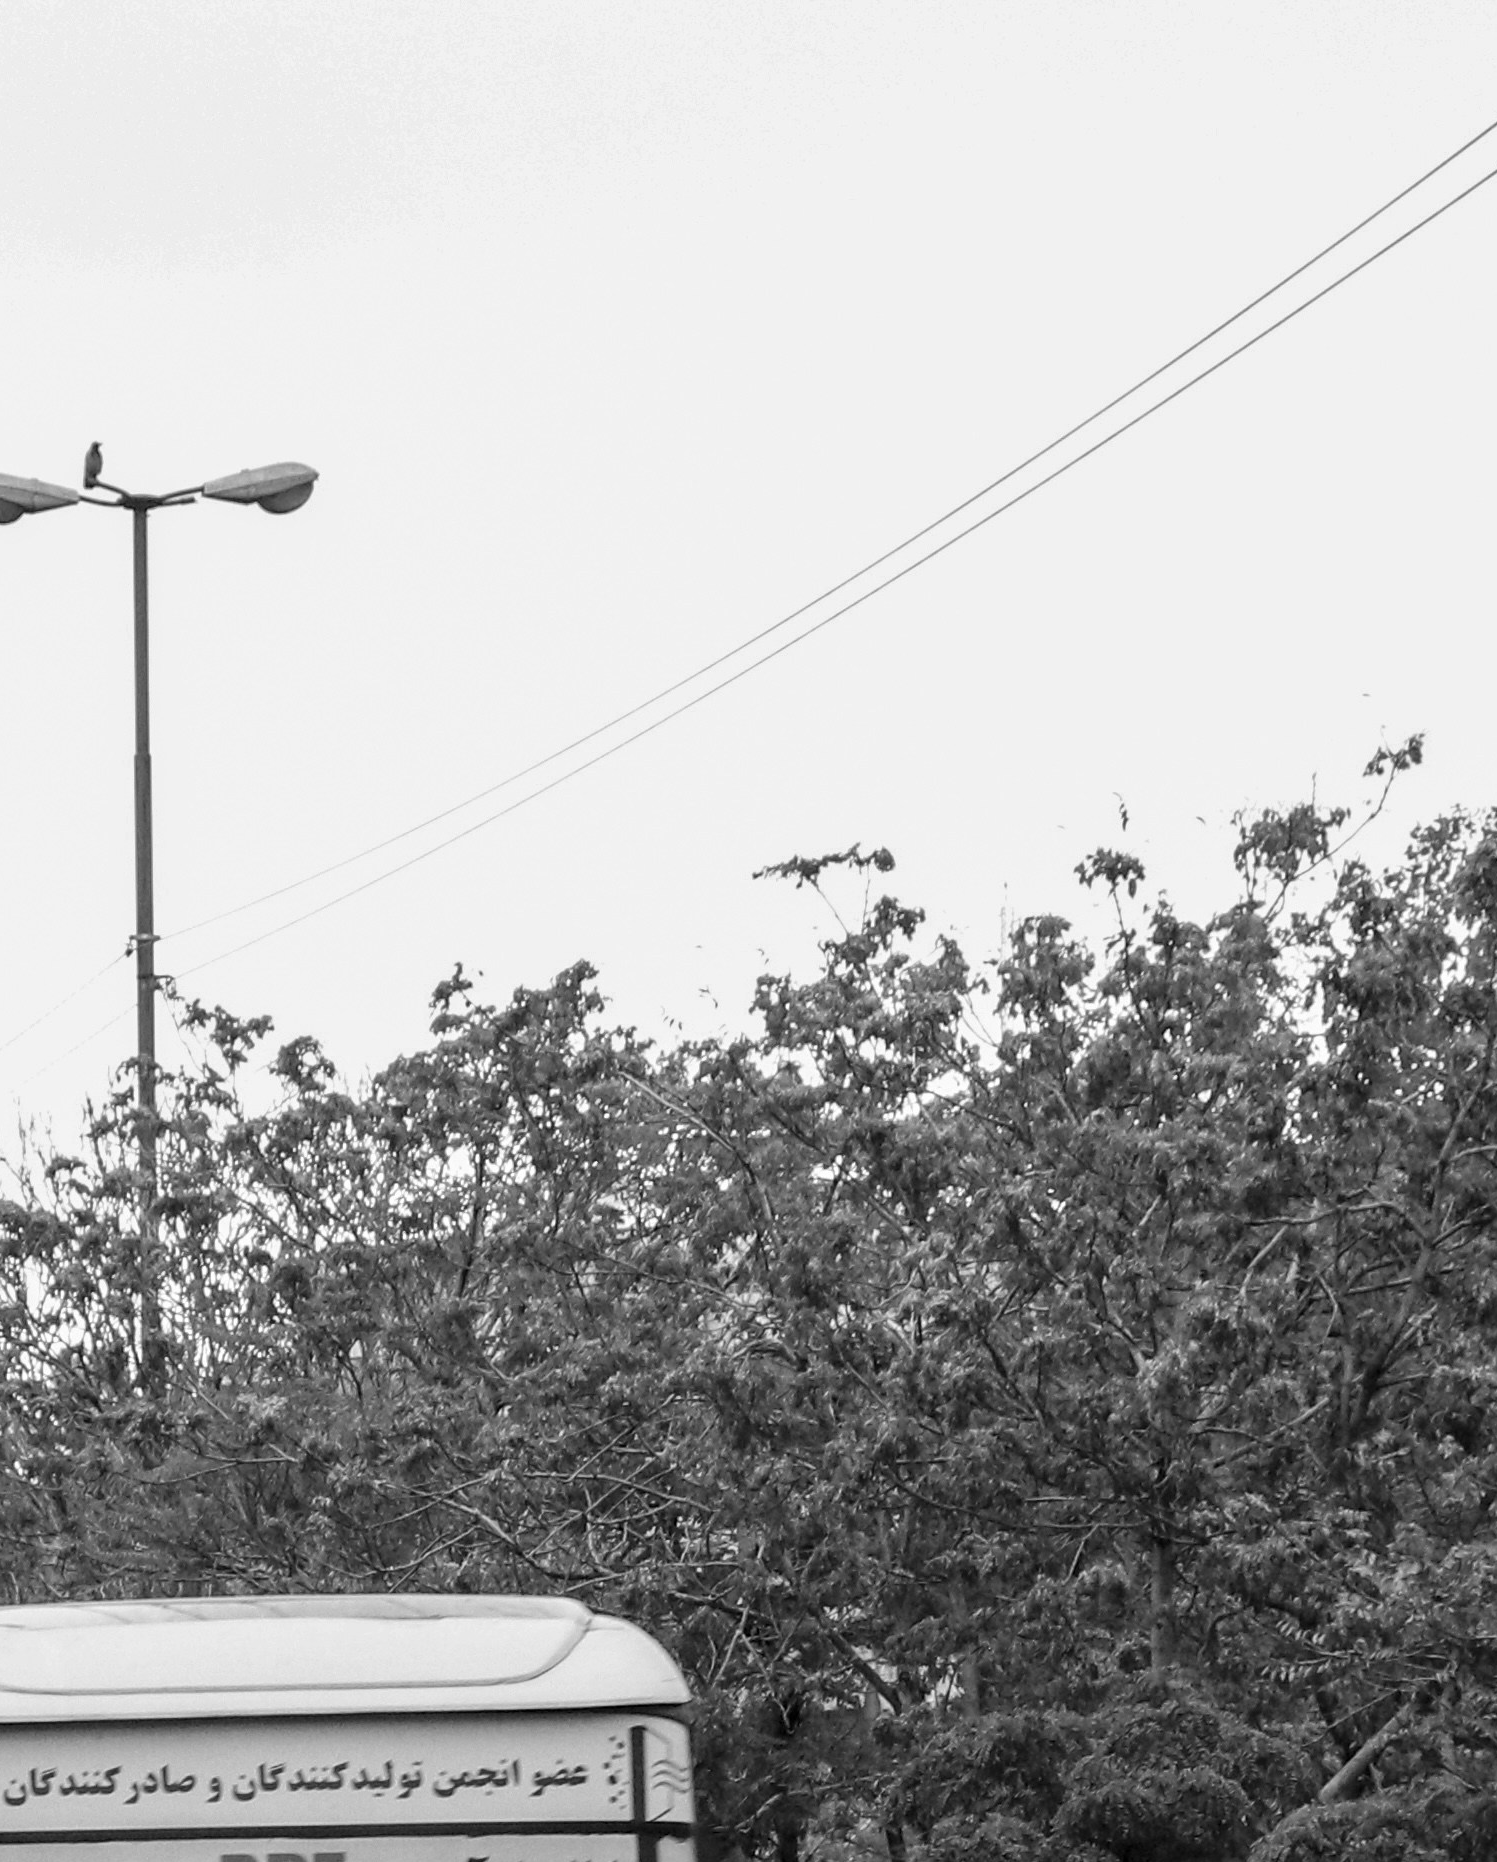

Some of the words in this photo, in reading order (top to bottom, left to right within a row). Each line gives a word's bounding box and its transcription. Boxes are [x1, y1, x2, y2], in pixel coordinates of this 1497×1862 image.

[205, 1774, 223, 1803] و
[434, 1758, 522, 1797] انجمن
[529, 1760, 589, 1796] عضو
